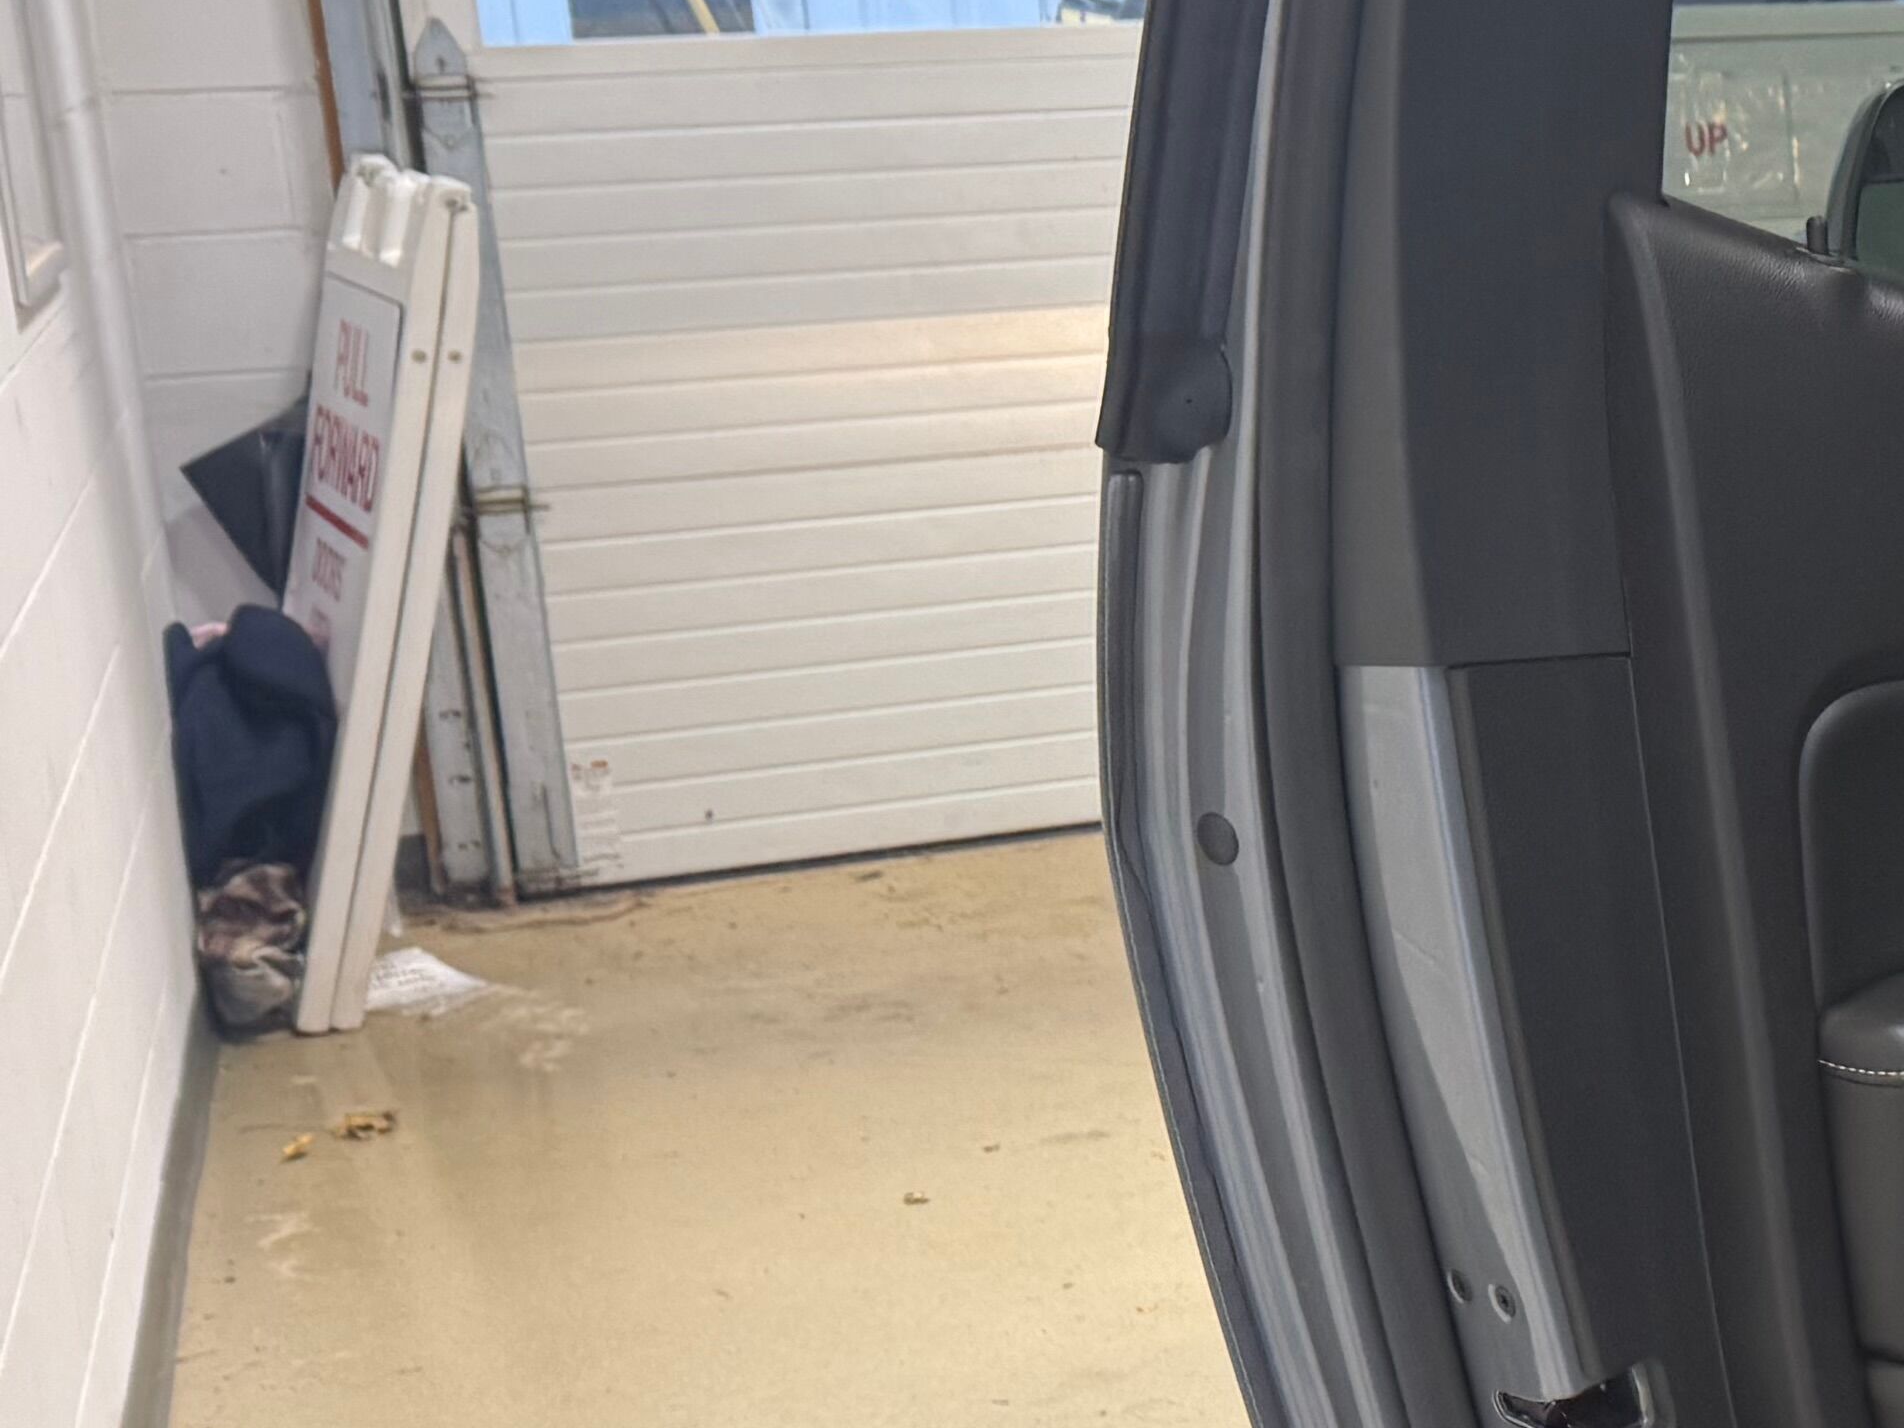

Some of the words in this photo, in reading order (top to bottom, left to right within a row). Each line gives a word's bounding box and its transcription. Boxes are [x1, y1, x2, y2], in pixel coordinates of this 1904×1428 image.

[1685, 121, 1728, 157] UP
[334, 319, 369, 408] PULL
[311, 404, 380, 513] FORWARD
